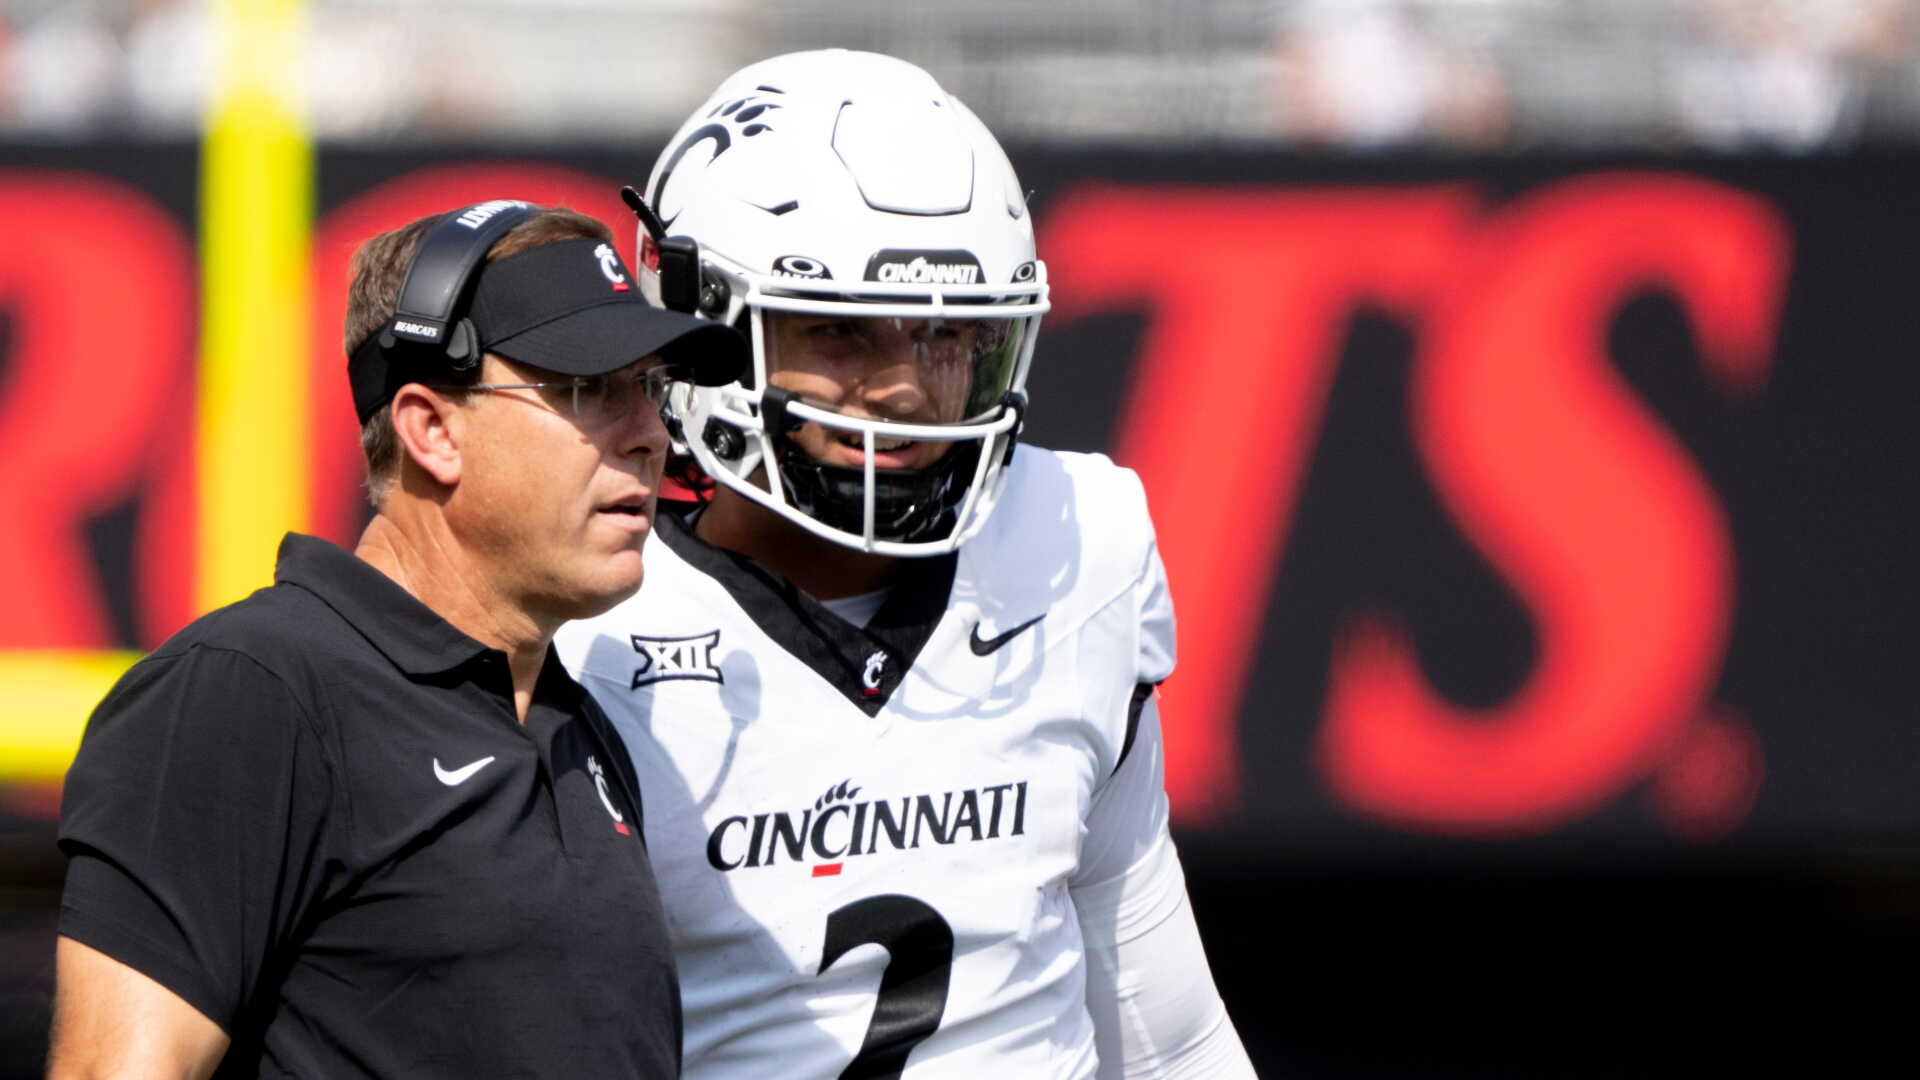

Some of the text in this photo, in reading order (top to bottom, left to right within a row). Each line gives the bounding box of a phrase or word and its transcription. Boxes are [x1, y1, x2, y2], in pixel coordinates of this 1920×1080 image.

[878, 257, 979, 284] CINCINNATI
[394, 320, 438, 337] BEARCATS
[630, 629, 724, 690] XII
[707, 778, 1028, 872] CINCINNATI
[816, 893, 954, 1080] 2
